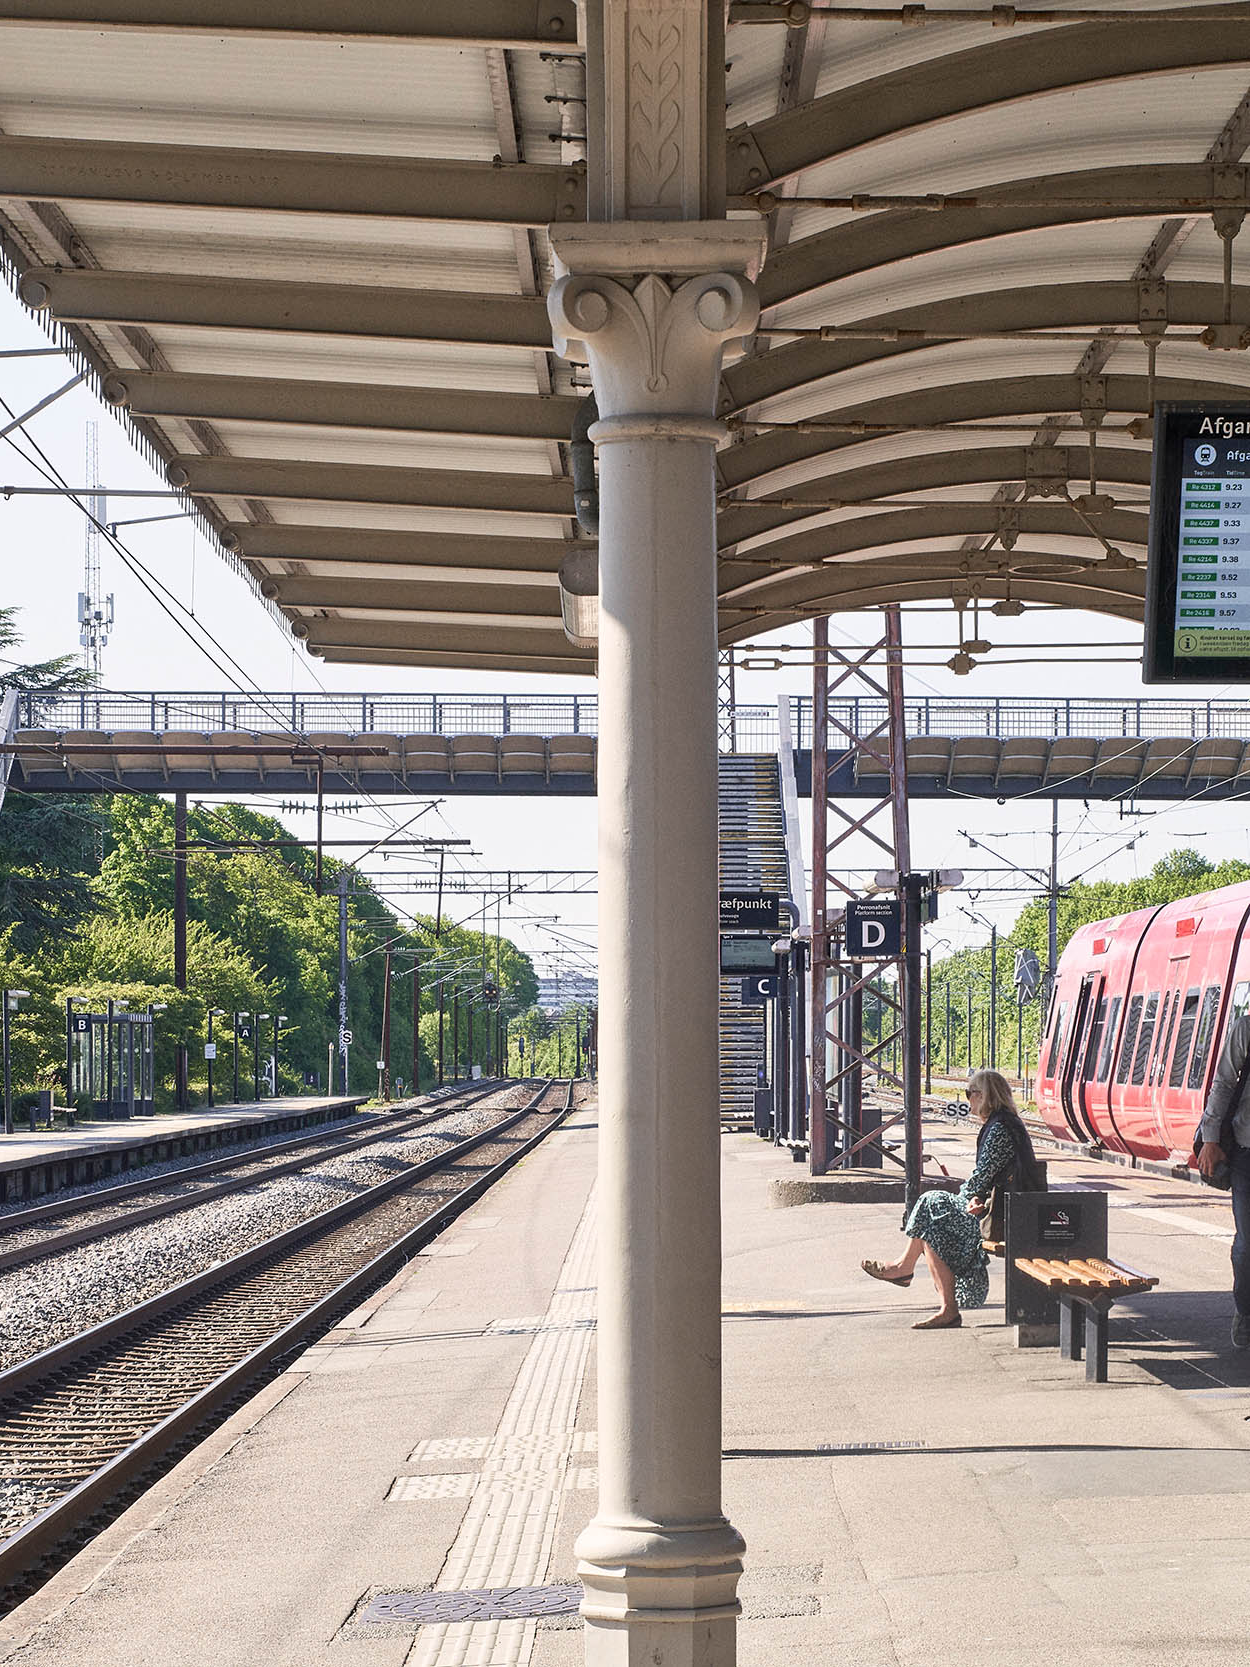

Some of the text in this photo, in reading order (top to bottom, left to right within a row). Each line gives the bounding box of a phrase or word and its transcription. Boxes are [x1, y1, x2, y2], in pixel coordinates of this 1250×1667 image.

[862, 920, 886, 948] D
[757, 979, 770, 994] C
[78, 1019, 86, 1030] B
[241, 1029, 249, 1037] A
[342, 1032, 351, 1043] S
[946, 1103, 969, 1117] SS
